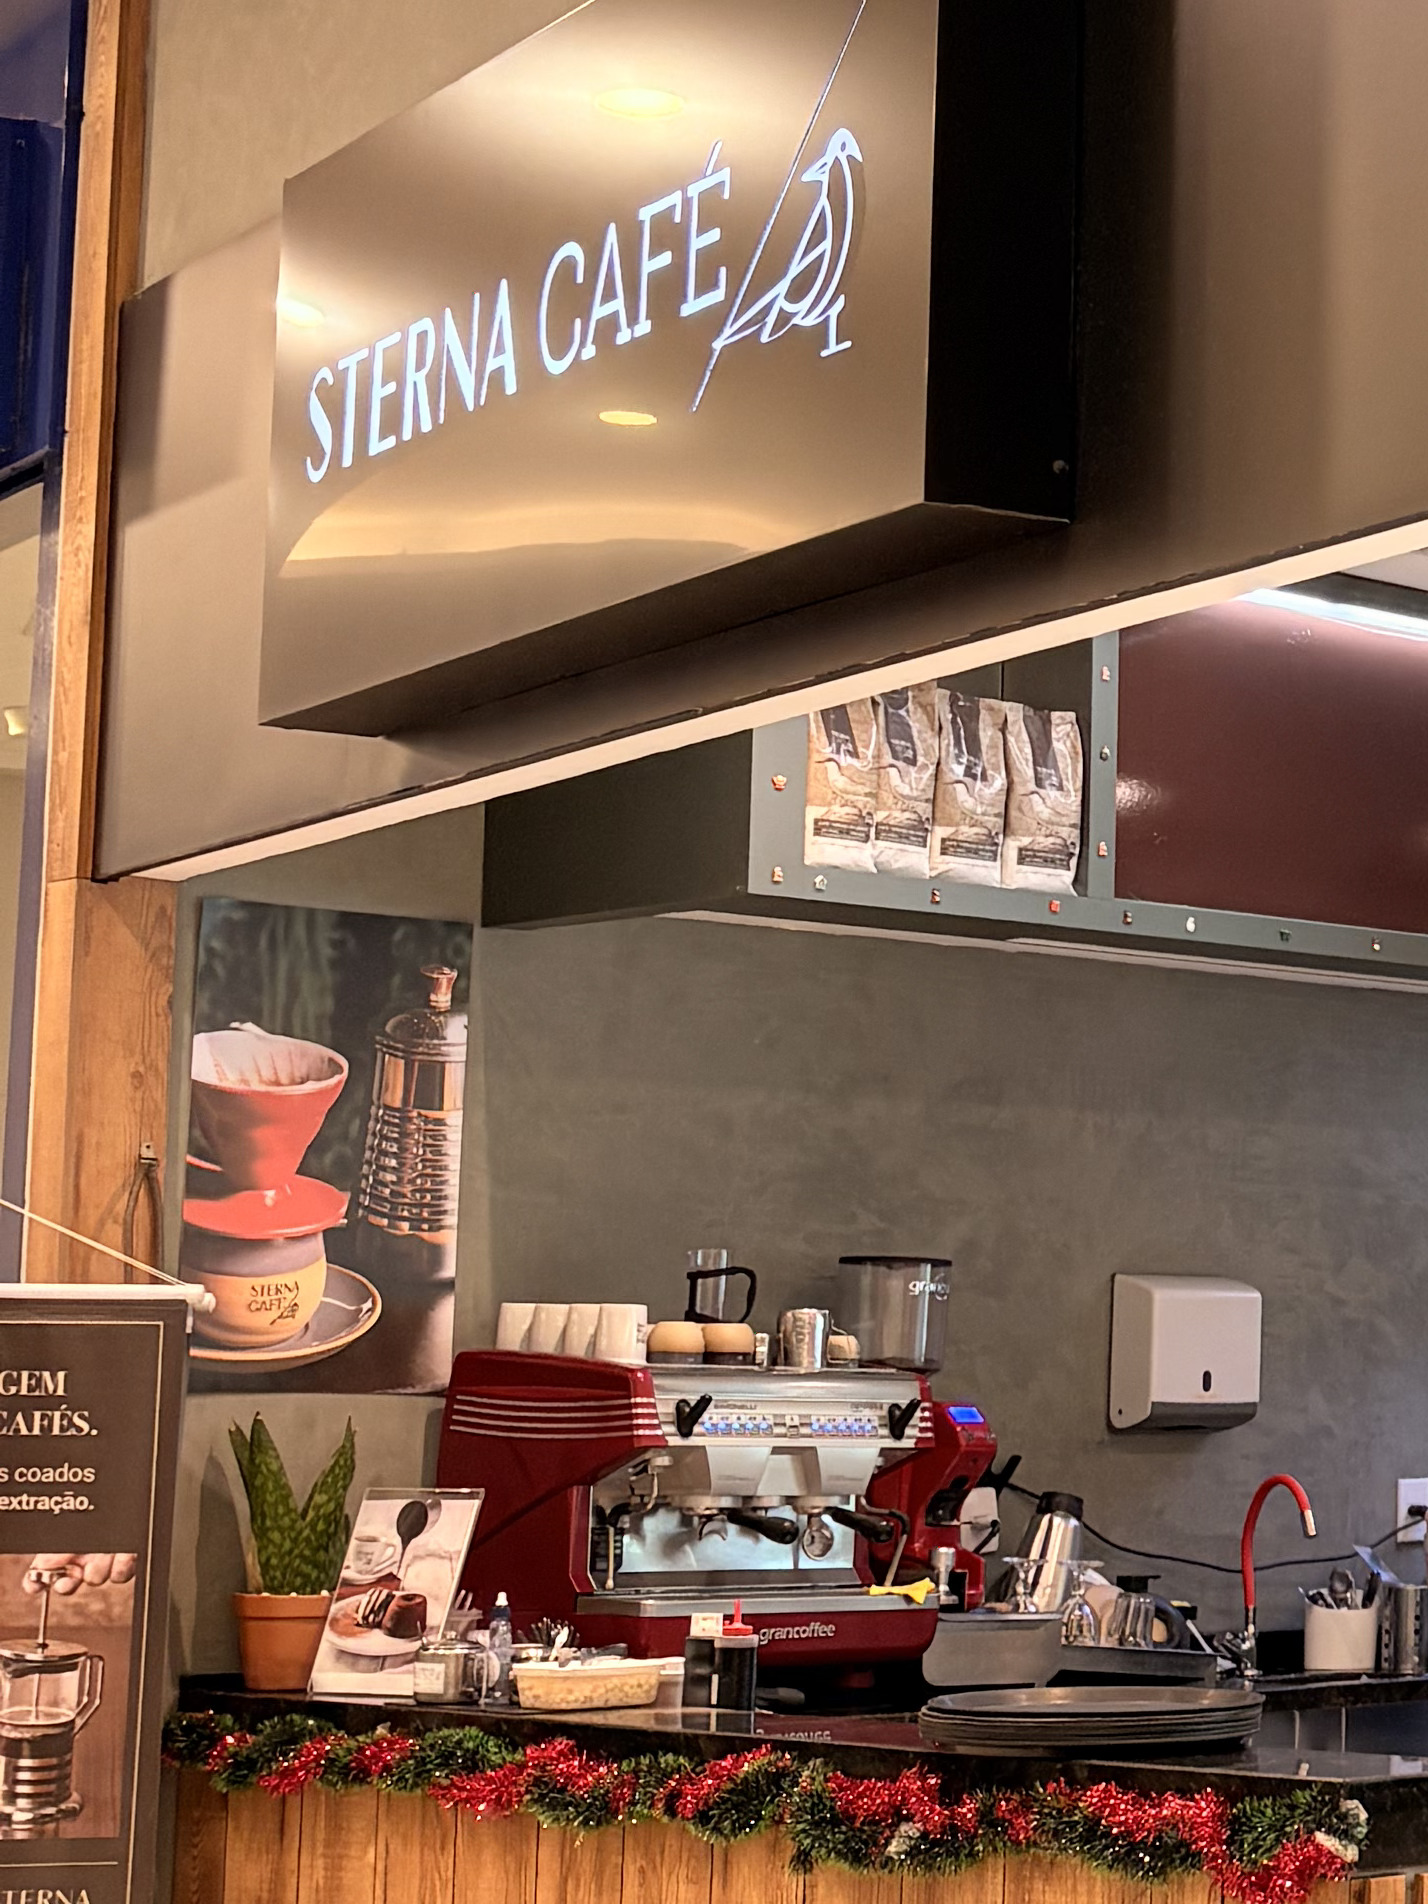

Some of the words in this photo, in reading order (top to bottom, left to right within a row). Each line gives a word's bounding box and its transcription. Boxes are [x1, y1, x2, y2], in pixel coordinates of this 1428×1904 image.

[306, 278, 518, 483] STERNA
[538, 139, 732, 375] CAFÉ
[14, 1462, 96, 1483] coados
[759, 1621, 836, 1646] grancoffee
